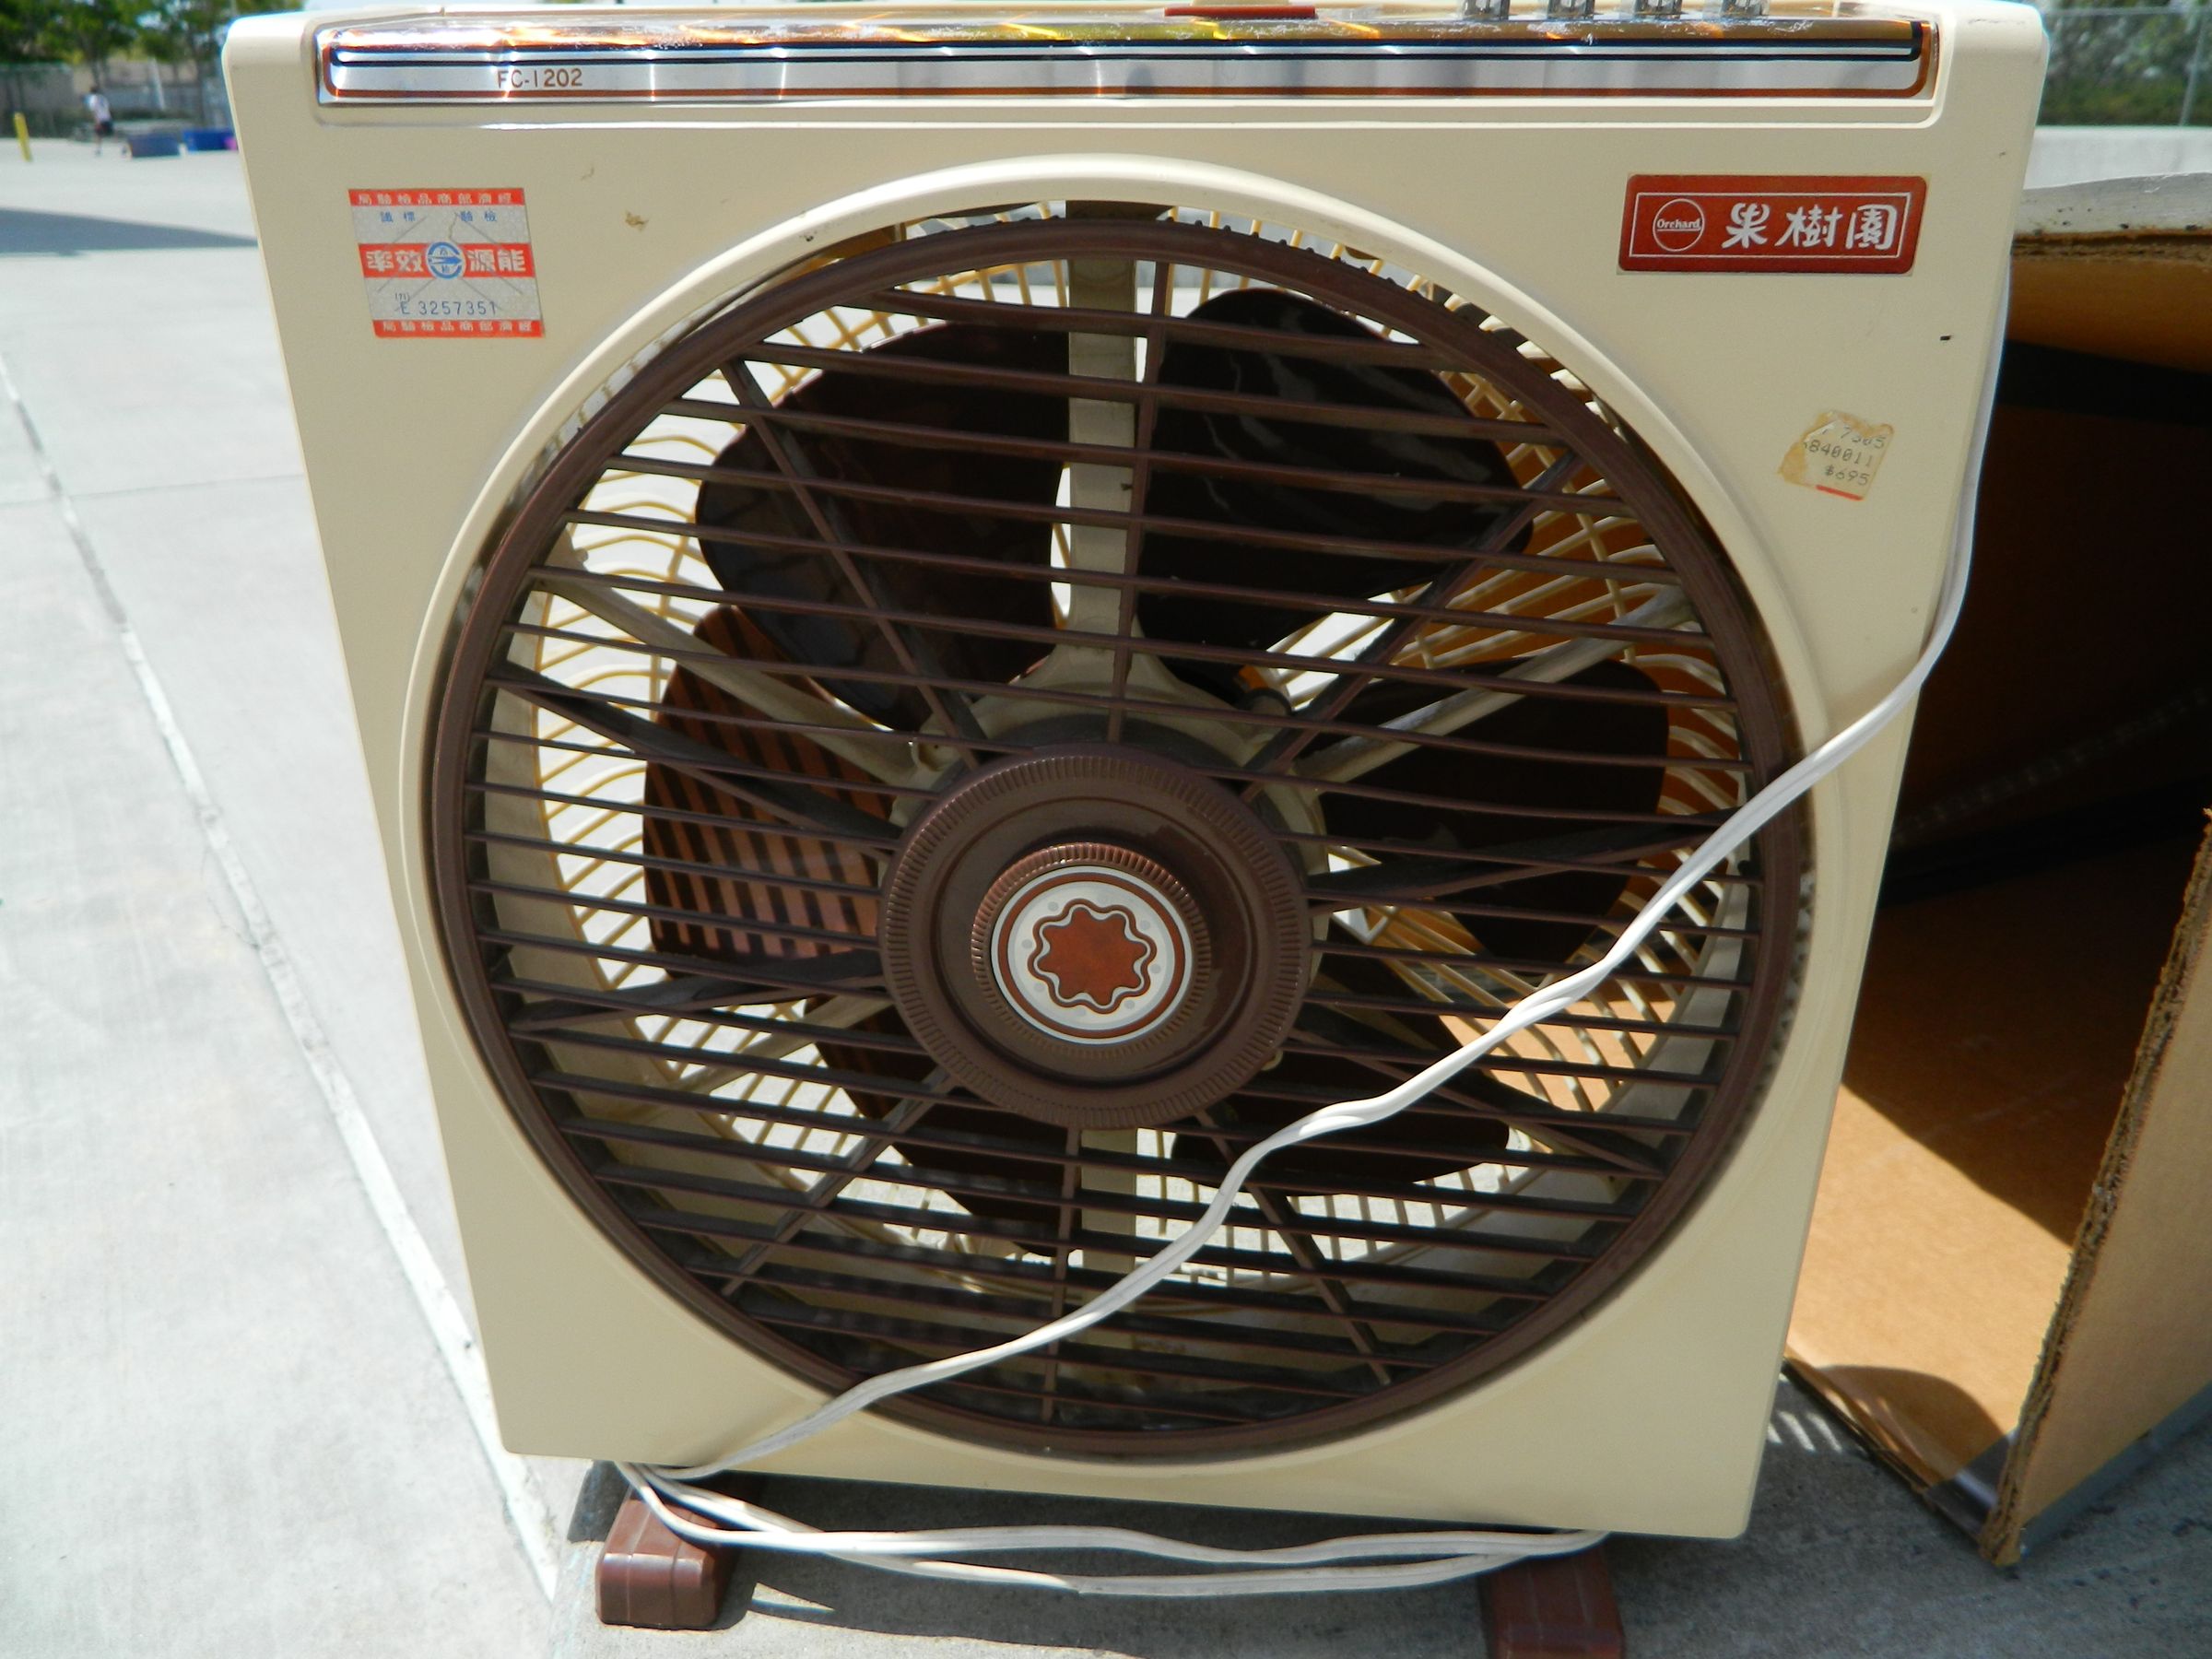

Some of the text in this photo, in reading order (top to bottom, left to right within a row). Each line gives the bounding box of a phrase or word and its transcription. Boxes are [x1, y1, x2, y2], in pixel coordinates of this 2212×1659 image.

[497, 68, 583, 88] FC-1202
[1656, 218, 1702, 230] Orchard
[418, 300, 499, 315] 3257351
[1824, 464, 1870, 486] $695
